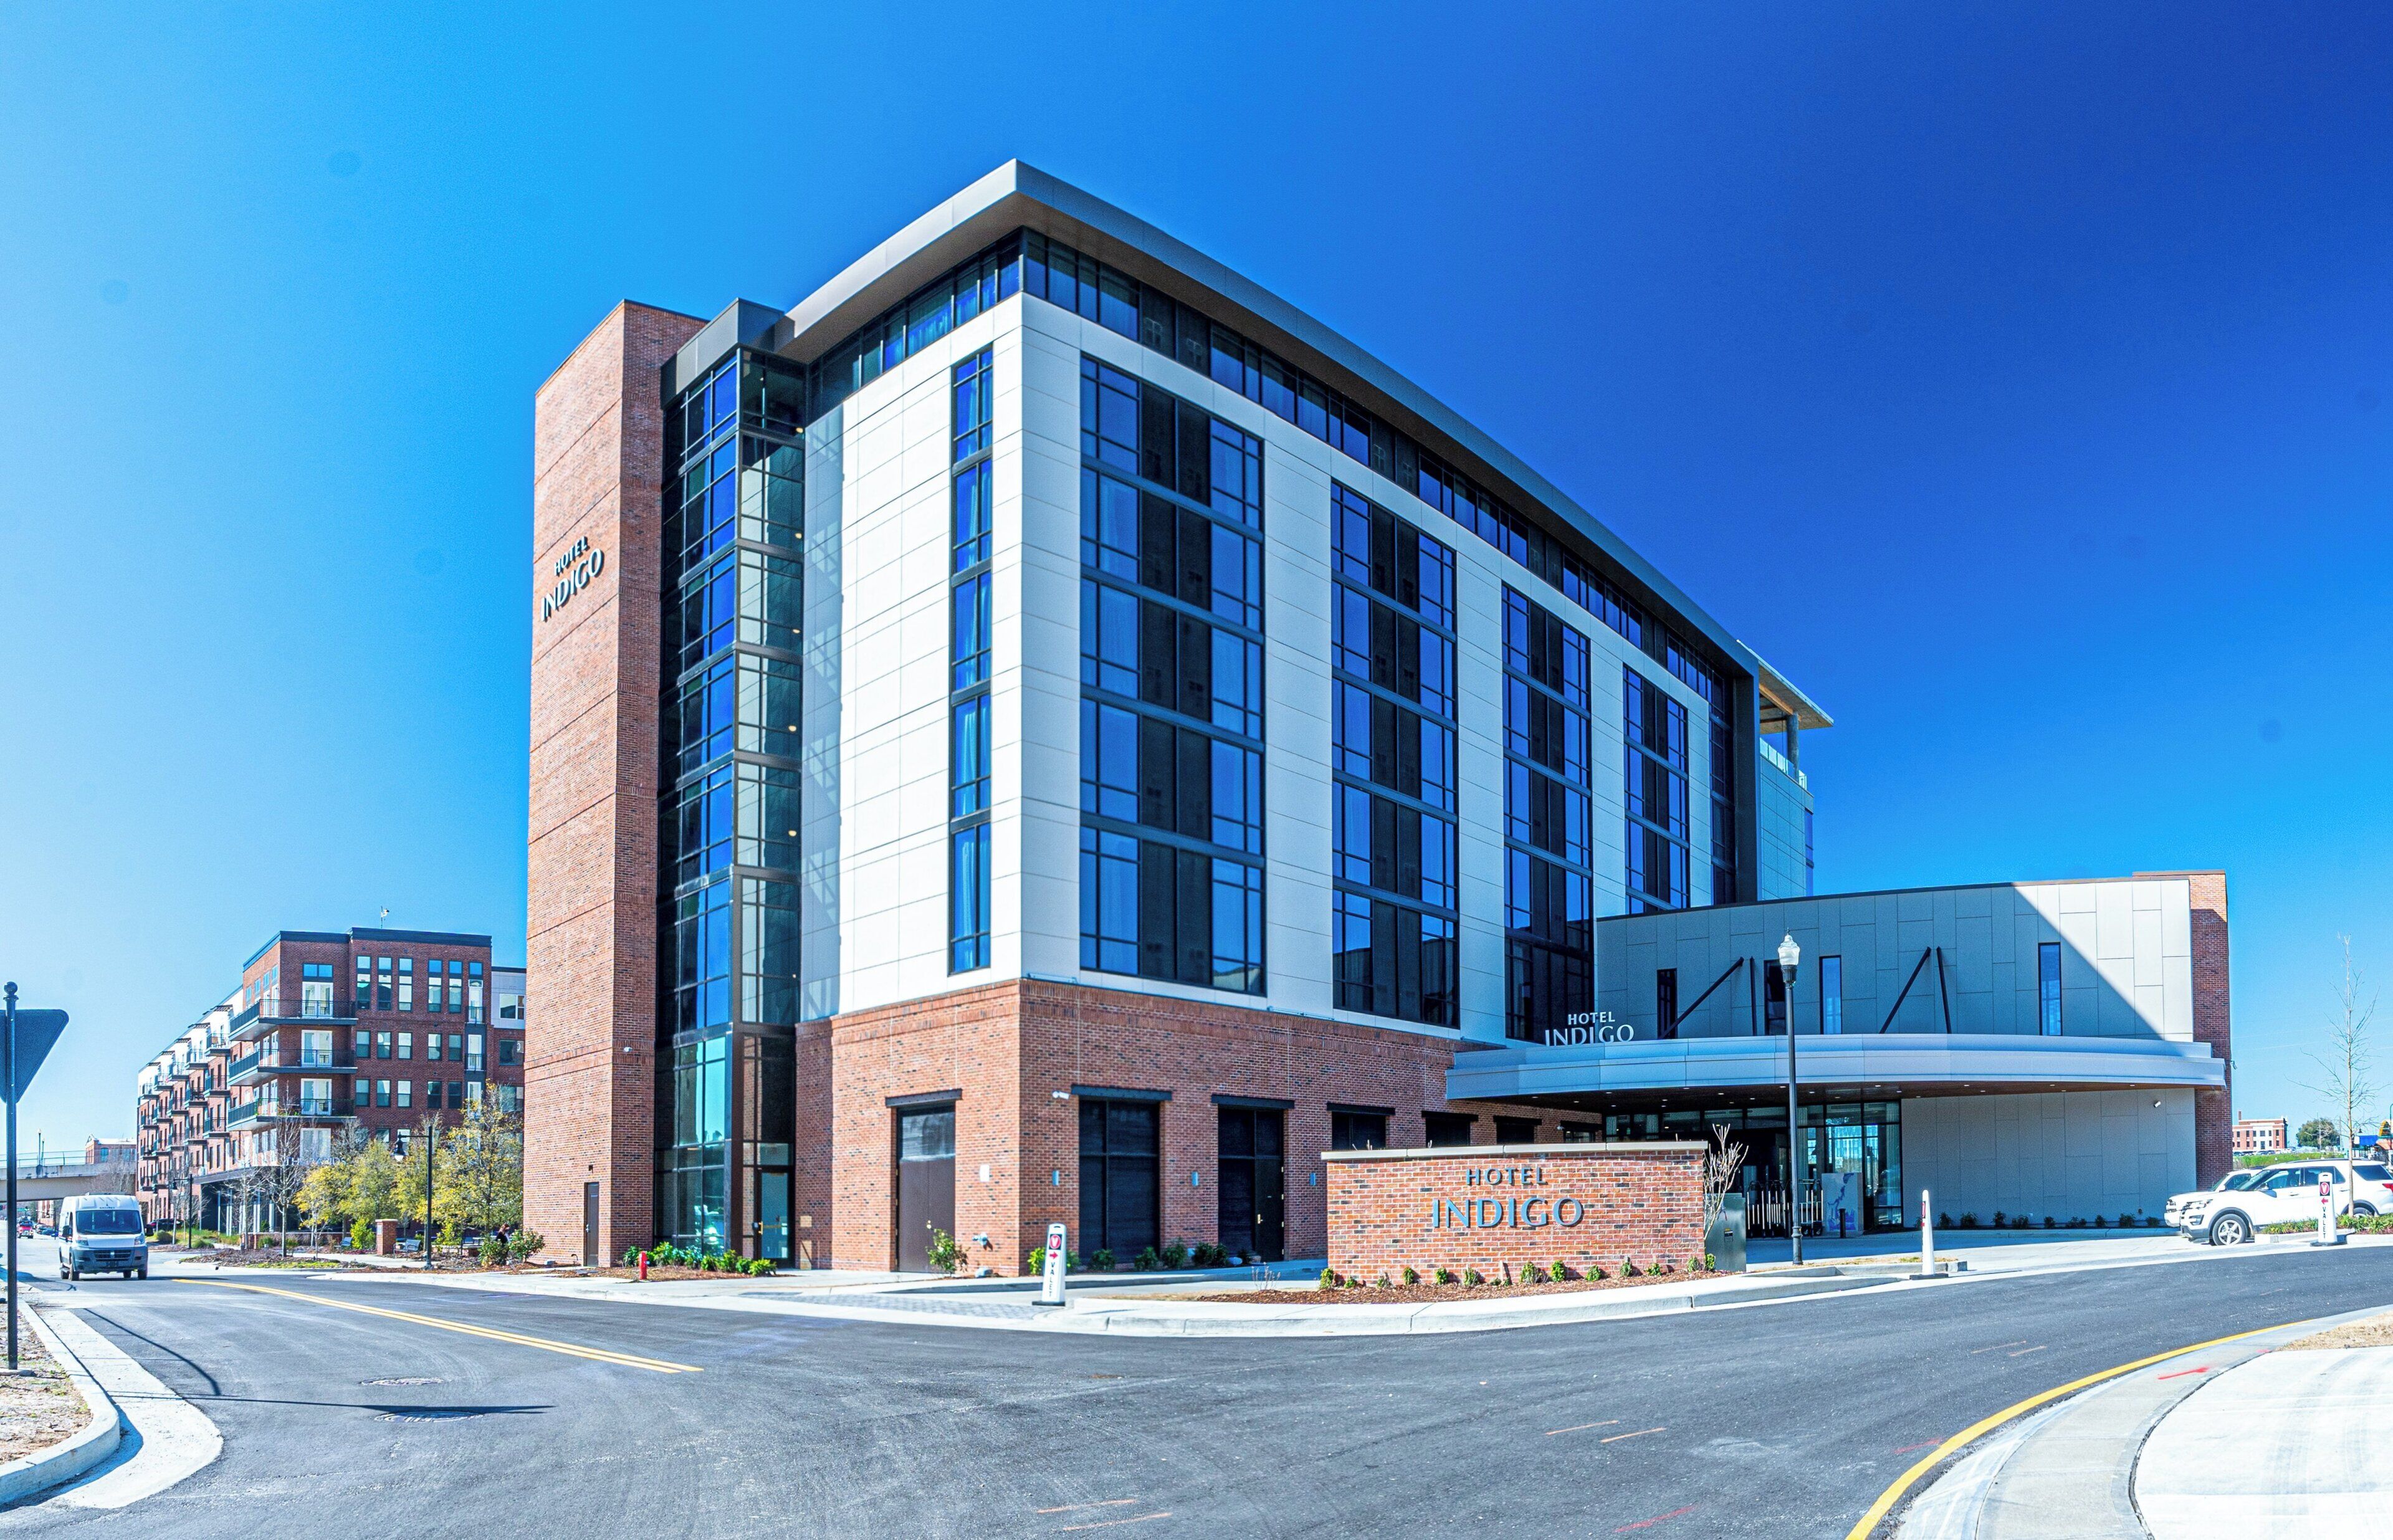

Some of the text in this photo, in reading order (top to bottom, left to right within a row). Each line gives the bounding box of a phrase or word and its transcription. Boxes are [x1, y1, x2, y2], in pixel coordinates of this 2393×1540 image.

[554, 535, 590, 576] HOTEL
[540, 548, 604, 622] INDIGO
[1567, 1011, 1615, 1025] HOTEL
[1545, 1024, 1635, 1046] INDIGO
[1466, 1167, 1549, 1186] HOTEL
[1431, 1197, 1584, 1228] INDIGO
